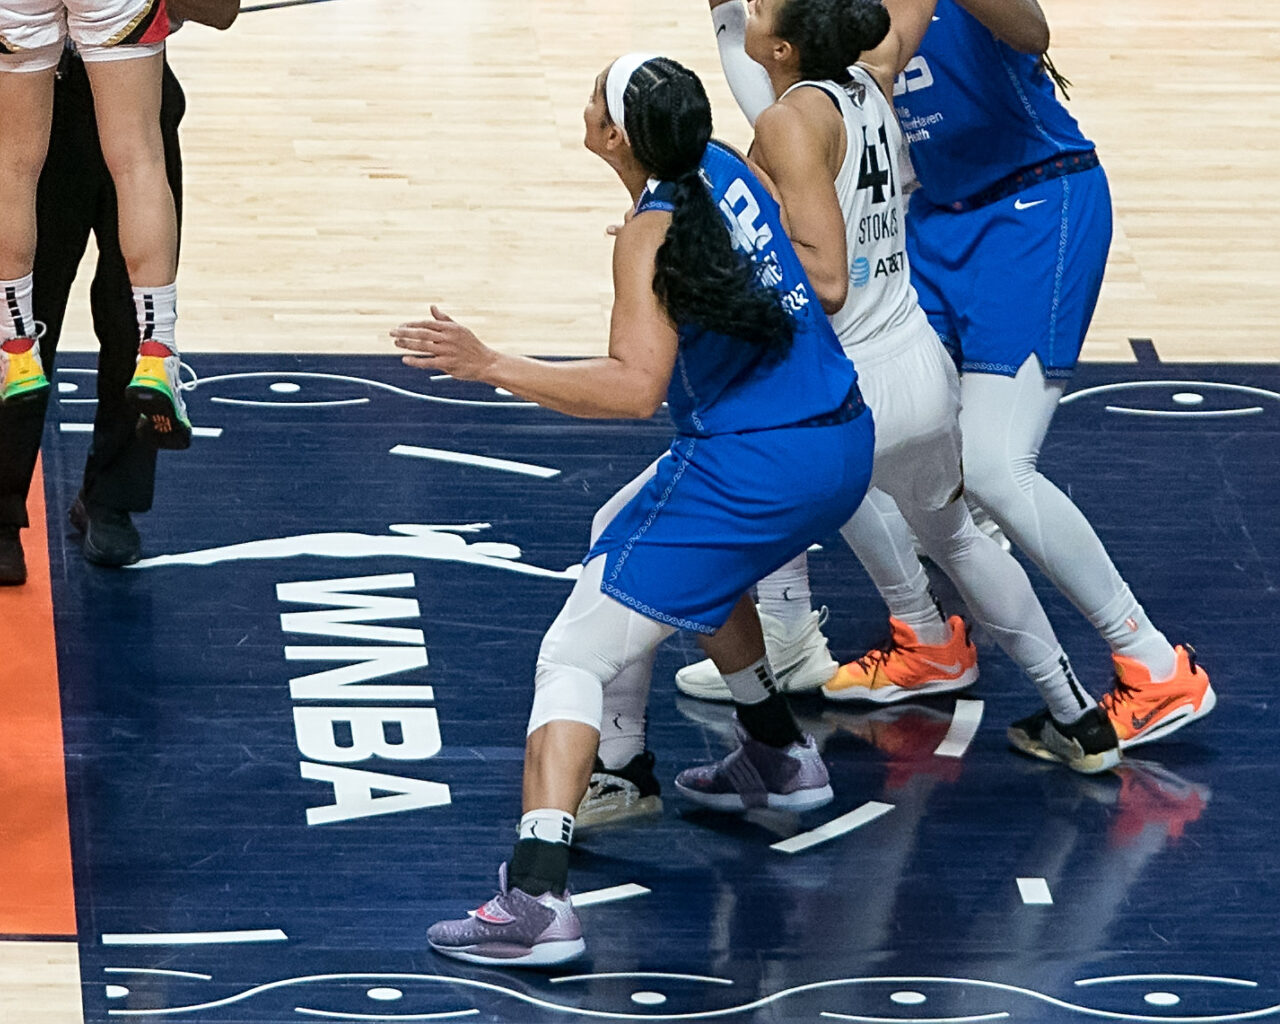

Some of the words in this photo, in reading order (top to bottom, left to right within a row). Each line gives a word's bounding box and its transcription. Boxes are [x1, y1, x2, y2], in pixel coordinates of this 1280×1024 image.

[856, 120, 896, 205] 41
[873, 251, 904, 279] AT&T
[275, 571, 453, 827] WNBA
